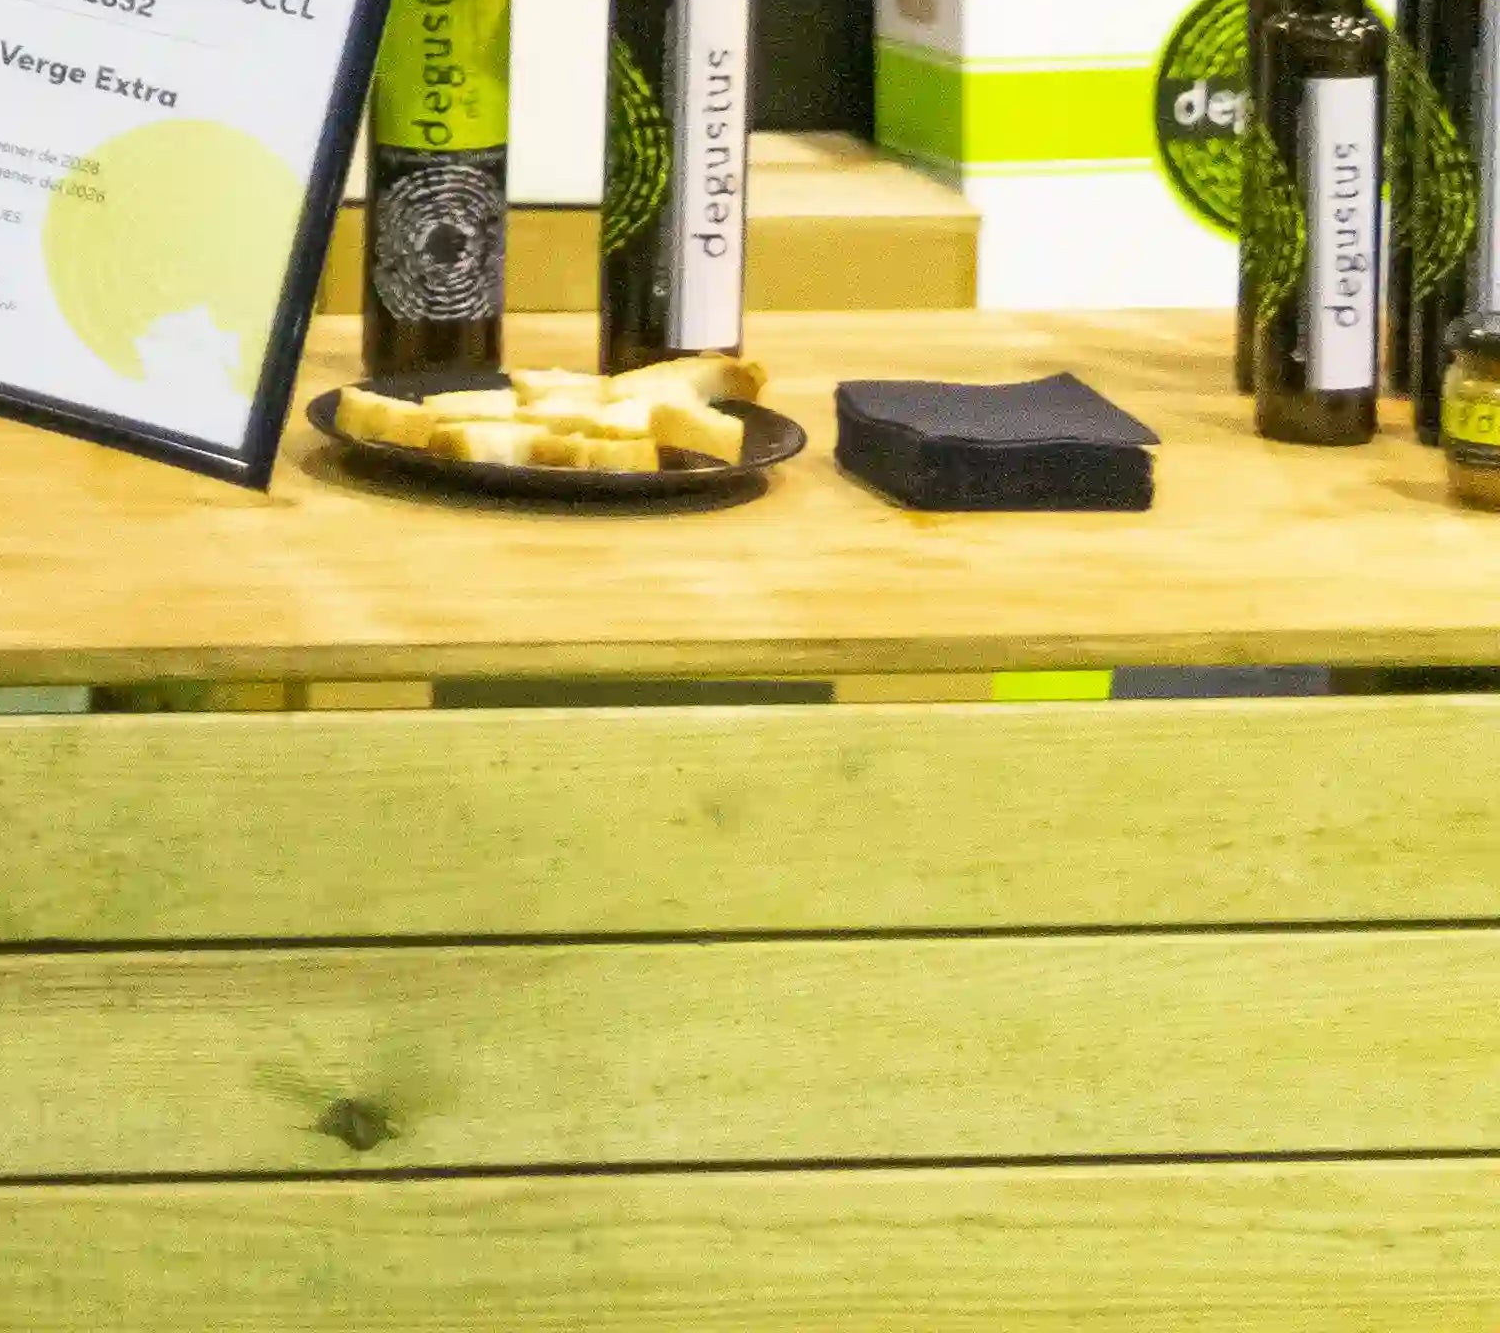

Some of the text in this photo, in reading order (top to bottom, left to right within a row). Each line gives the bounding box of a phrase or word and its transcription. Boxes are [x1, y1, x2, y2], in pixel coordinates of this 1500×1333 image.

[0, 39, 87, 85] Verge
[93, 64, 178, 108] Extra
[693, 47, 740, 259] degustus
[1325, 142, 1368, 327] degustus
